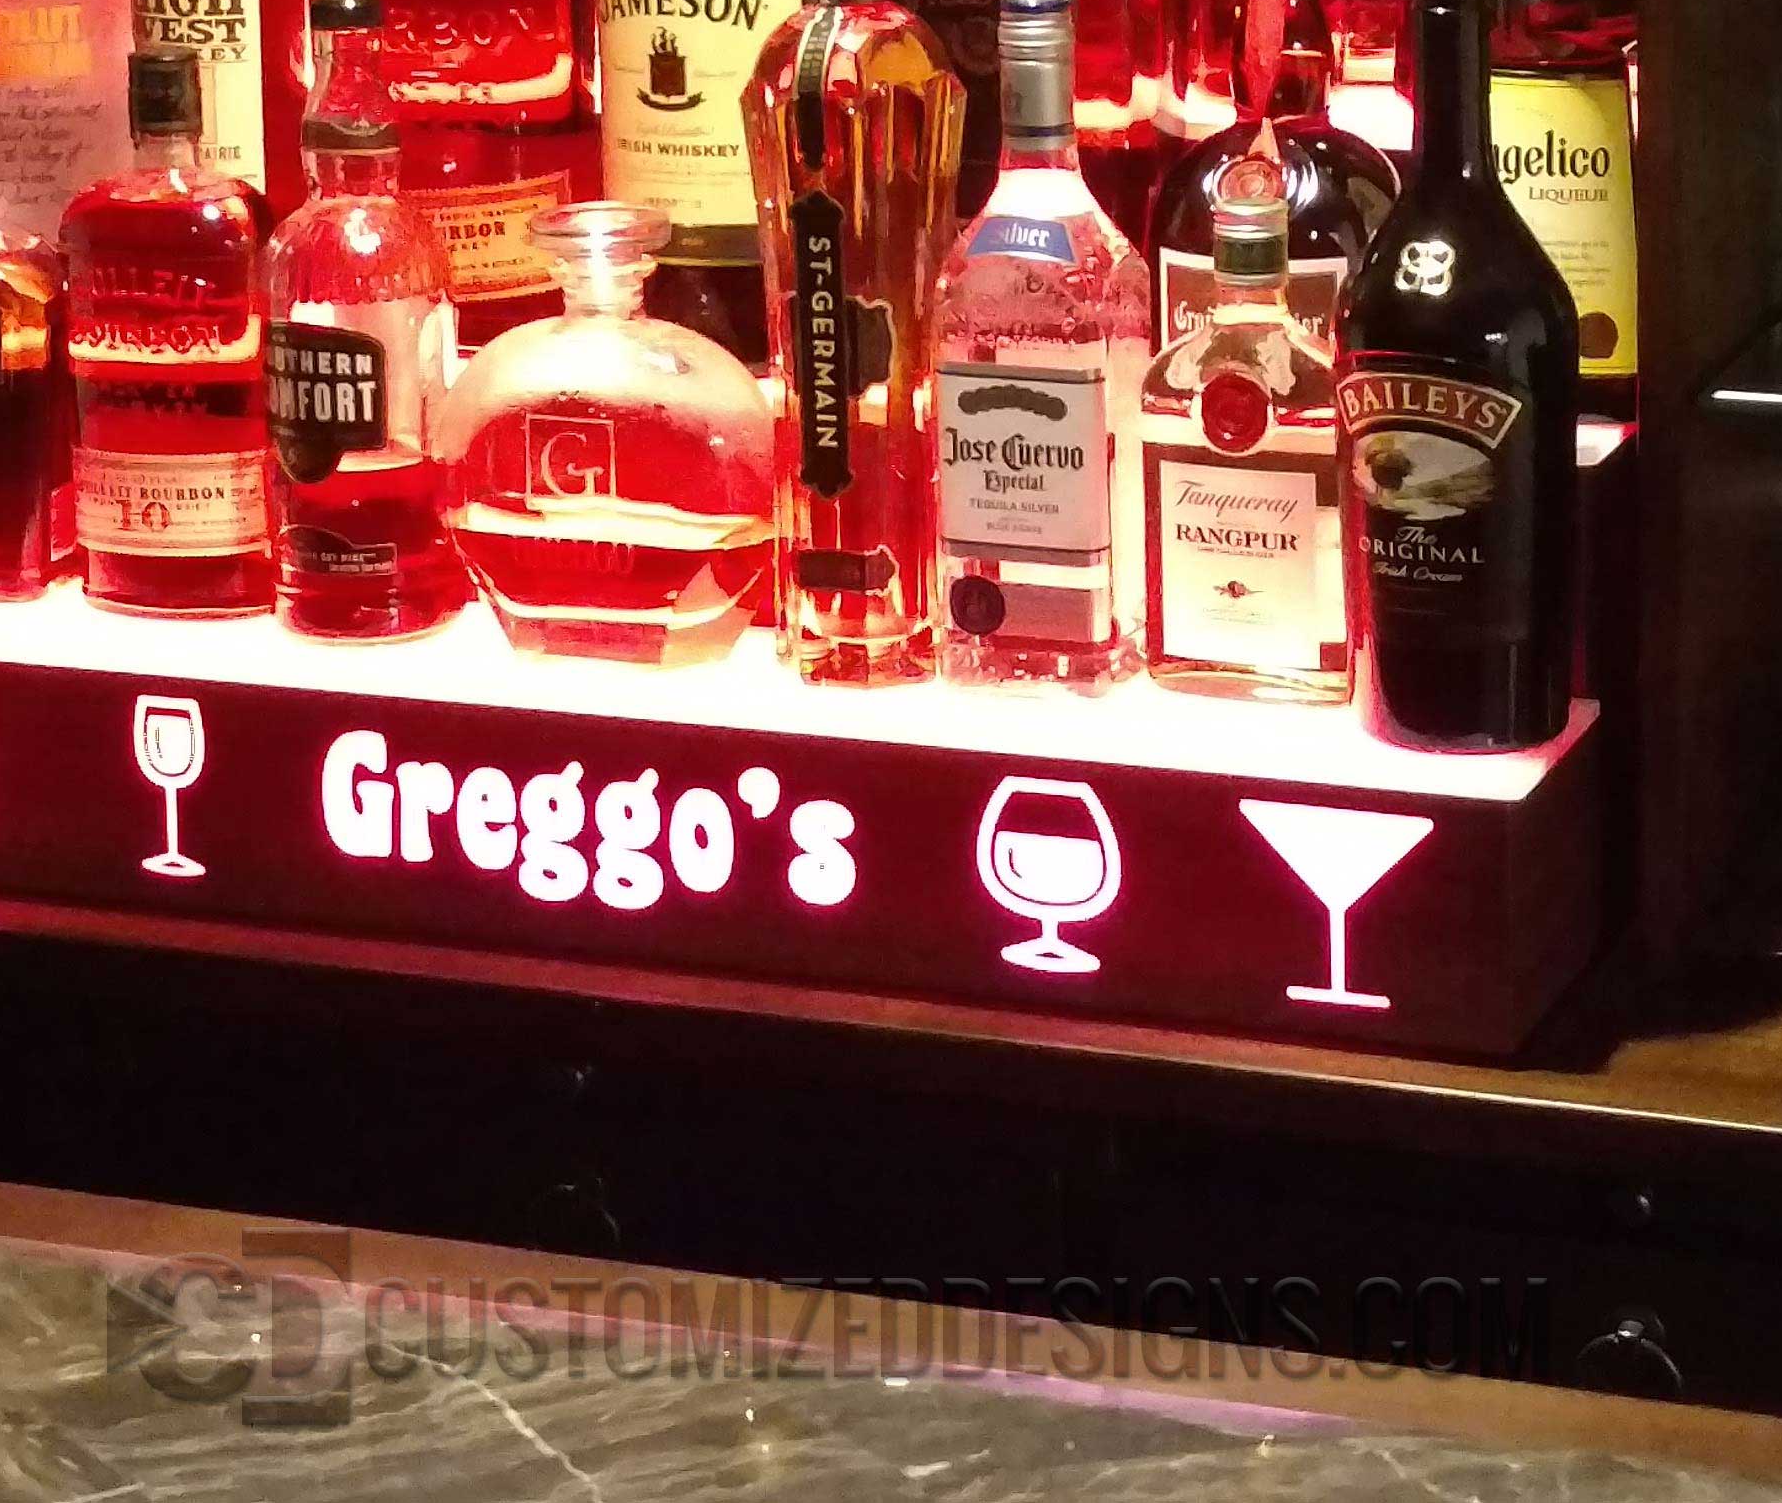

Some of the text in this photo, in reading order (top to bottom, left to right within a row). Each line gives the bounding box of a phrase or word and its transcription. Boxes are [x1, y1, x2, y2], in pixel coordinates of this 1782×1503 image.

[657, 141, 740, 158] WHISKEY
[1492, 129, 1611, 184] gelico
[995, 222, 1051, 248] ilver
[807, 234, 840, 448] ST-GERMAIN
[1343, 380, 1508, 429] BAILEYS
[540, 431, 605, 499] G
[944, 427, 1085, 471] Jose Cuervo
[139, 487, 226, 501] BOURBON
[983, 469, 1046, 494] Especial
[968, 497, 1060, 515] TEQUILA SILVER
[1175, 479, 1299, 524] Tanqueray
[1175, 522, 1300, 552] RANGPUR
[1358, 535, 1486, 564] ORIGINAL
[321, 729, 857, 910] Greggo's
